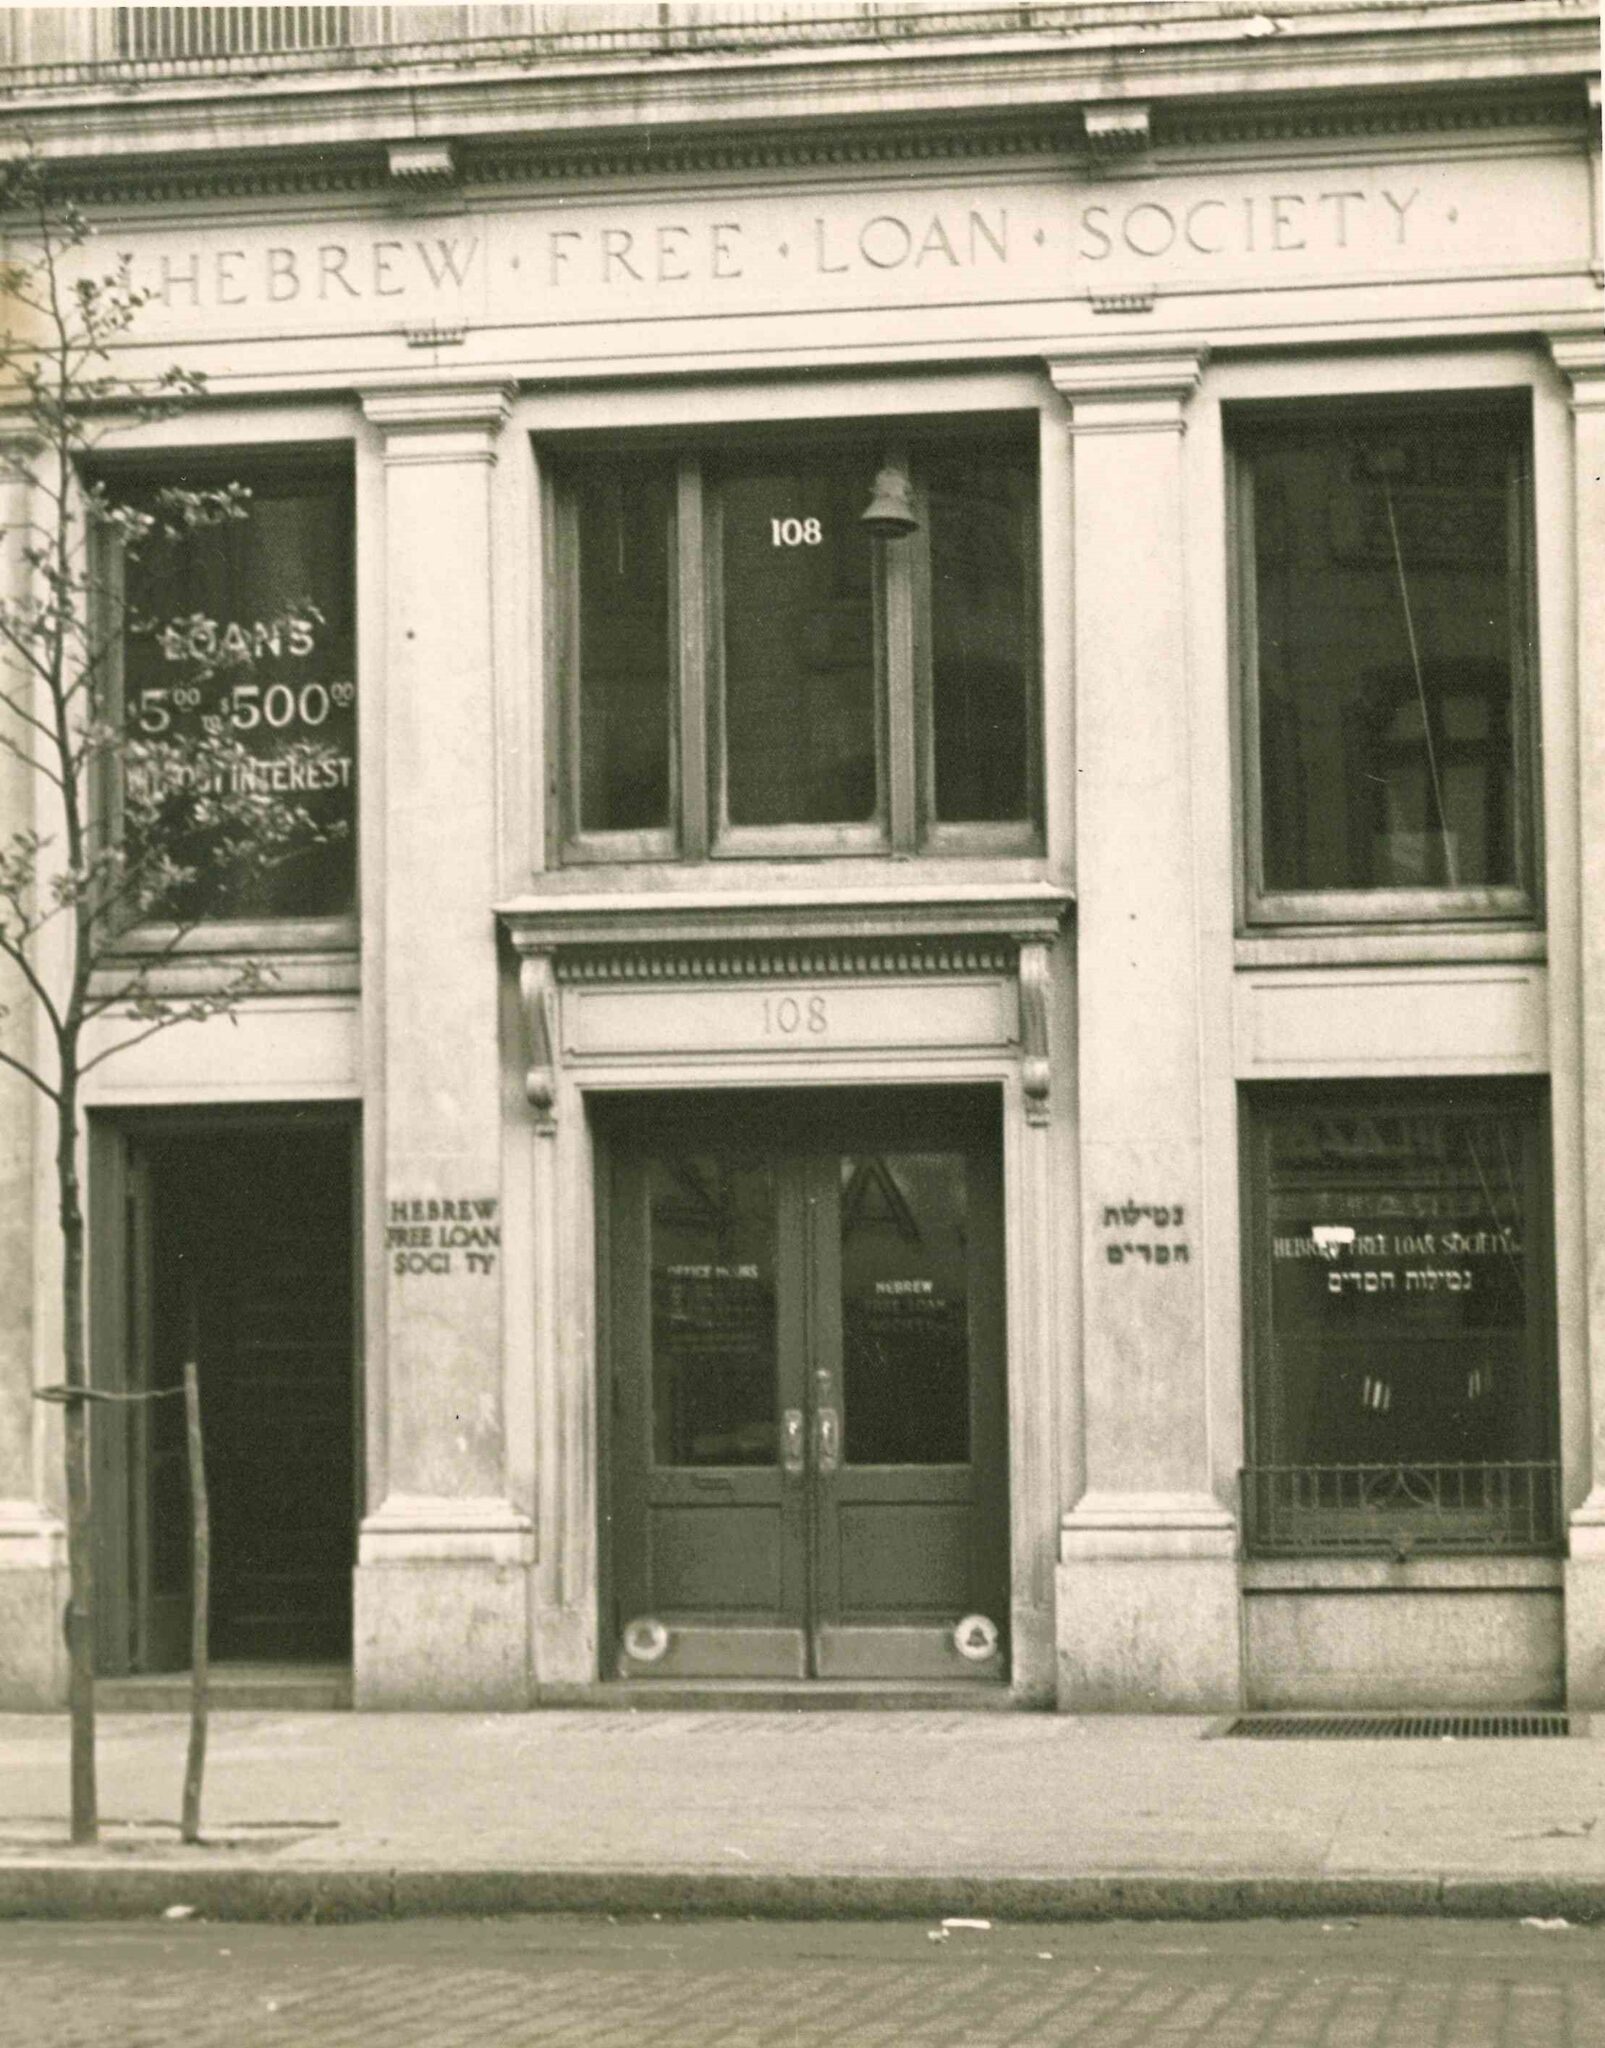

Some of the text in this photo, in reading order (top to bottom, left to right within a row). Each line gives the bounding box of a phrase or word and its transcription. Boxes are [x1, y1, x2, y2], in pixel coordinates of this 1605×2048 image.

[160, 189, 1420, 307] HEBREW FREE LOAN SOCIETY
[771, 517, 822, 547] 108
[763, 996, 827, 1034] 108
[391, 1199, 497, 1222] HEBREW
[440, 1225, 501, 1248] LOAN
